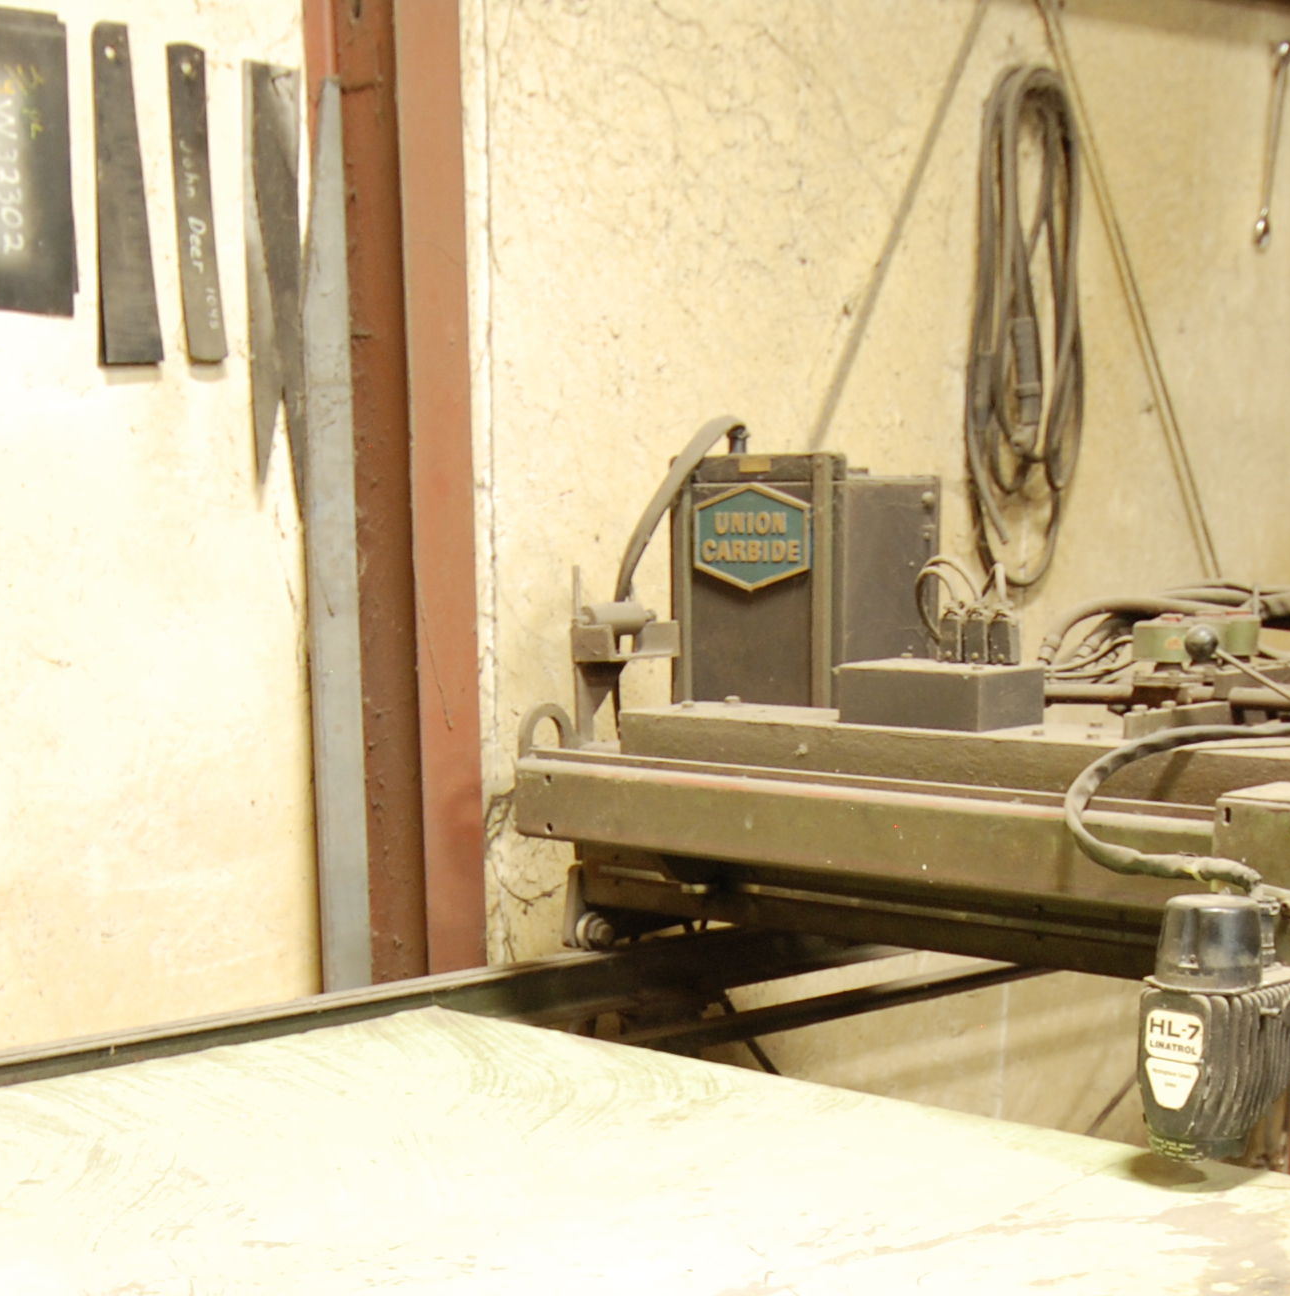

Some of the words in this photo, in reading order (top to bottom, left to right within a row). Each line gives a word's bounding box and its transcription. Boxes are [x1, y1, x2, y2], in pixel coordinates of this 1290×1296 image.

[179, 140, 201, 198] John
[187, 215, 207, 275] Deer
[713, 511, 787, 535] UNION
[701, 539, 801, 563] CARBIDE
[1149, 1017, 1200, 1040] HL-7
[1149, 1039, 1197, 1056] LINATROL
